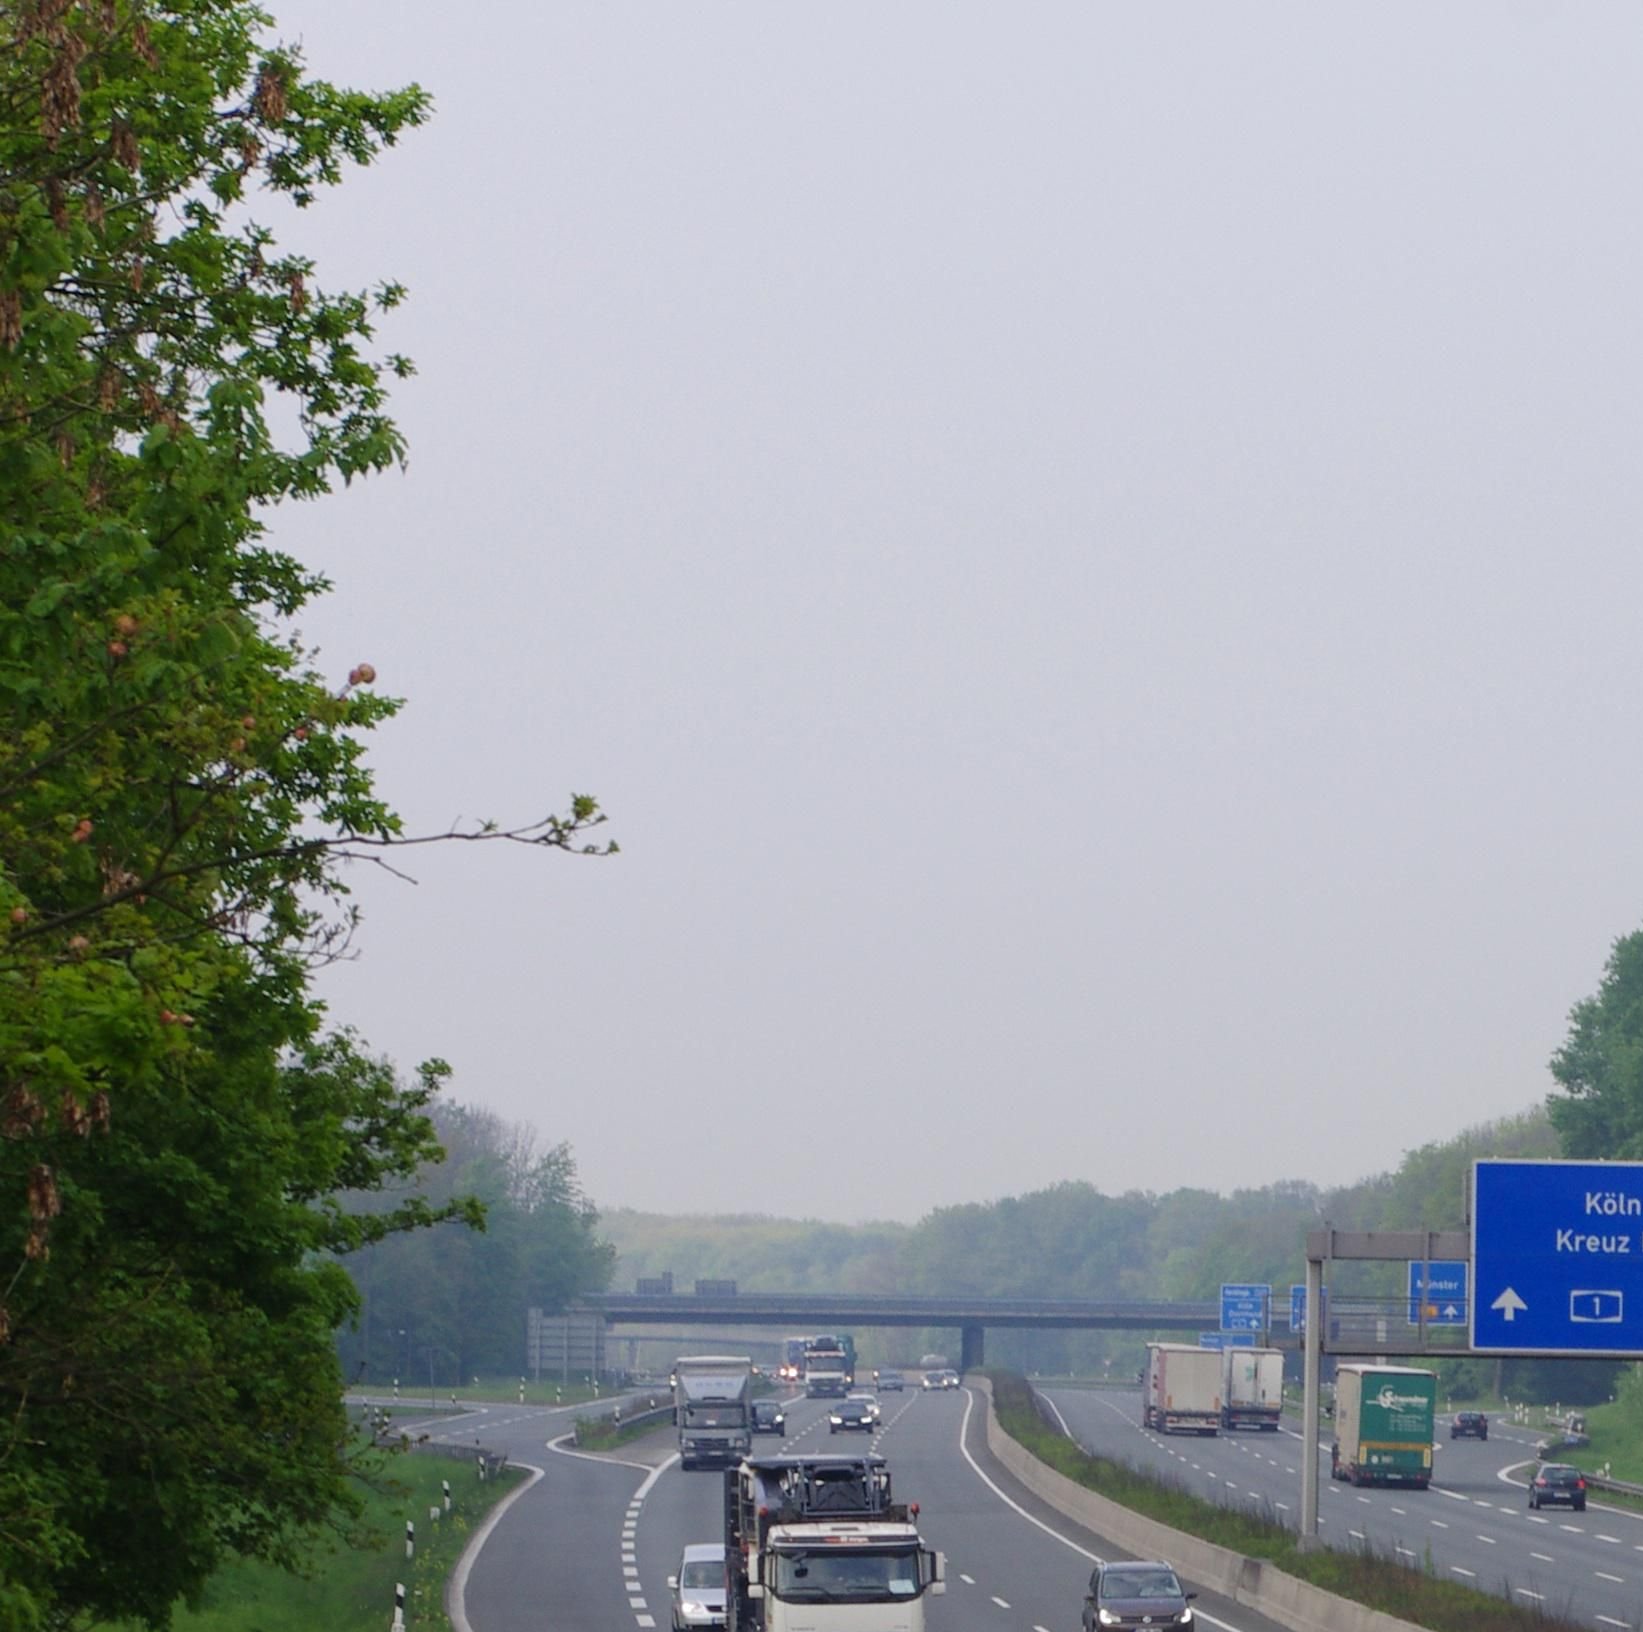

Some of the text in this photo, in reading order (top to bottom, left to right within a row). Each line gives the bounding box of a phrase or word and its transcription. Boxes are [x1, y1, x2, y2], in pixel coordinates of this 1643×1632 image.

[1585, 1192, 1642, 1216] Köln
[1556, 1229, 1631, 1253] Kreuz
[1593, 1297, 1600, 1316] 1
